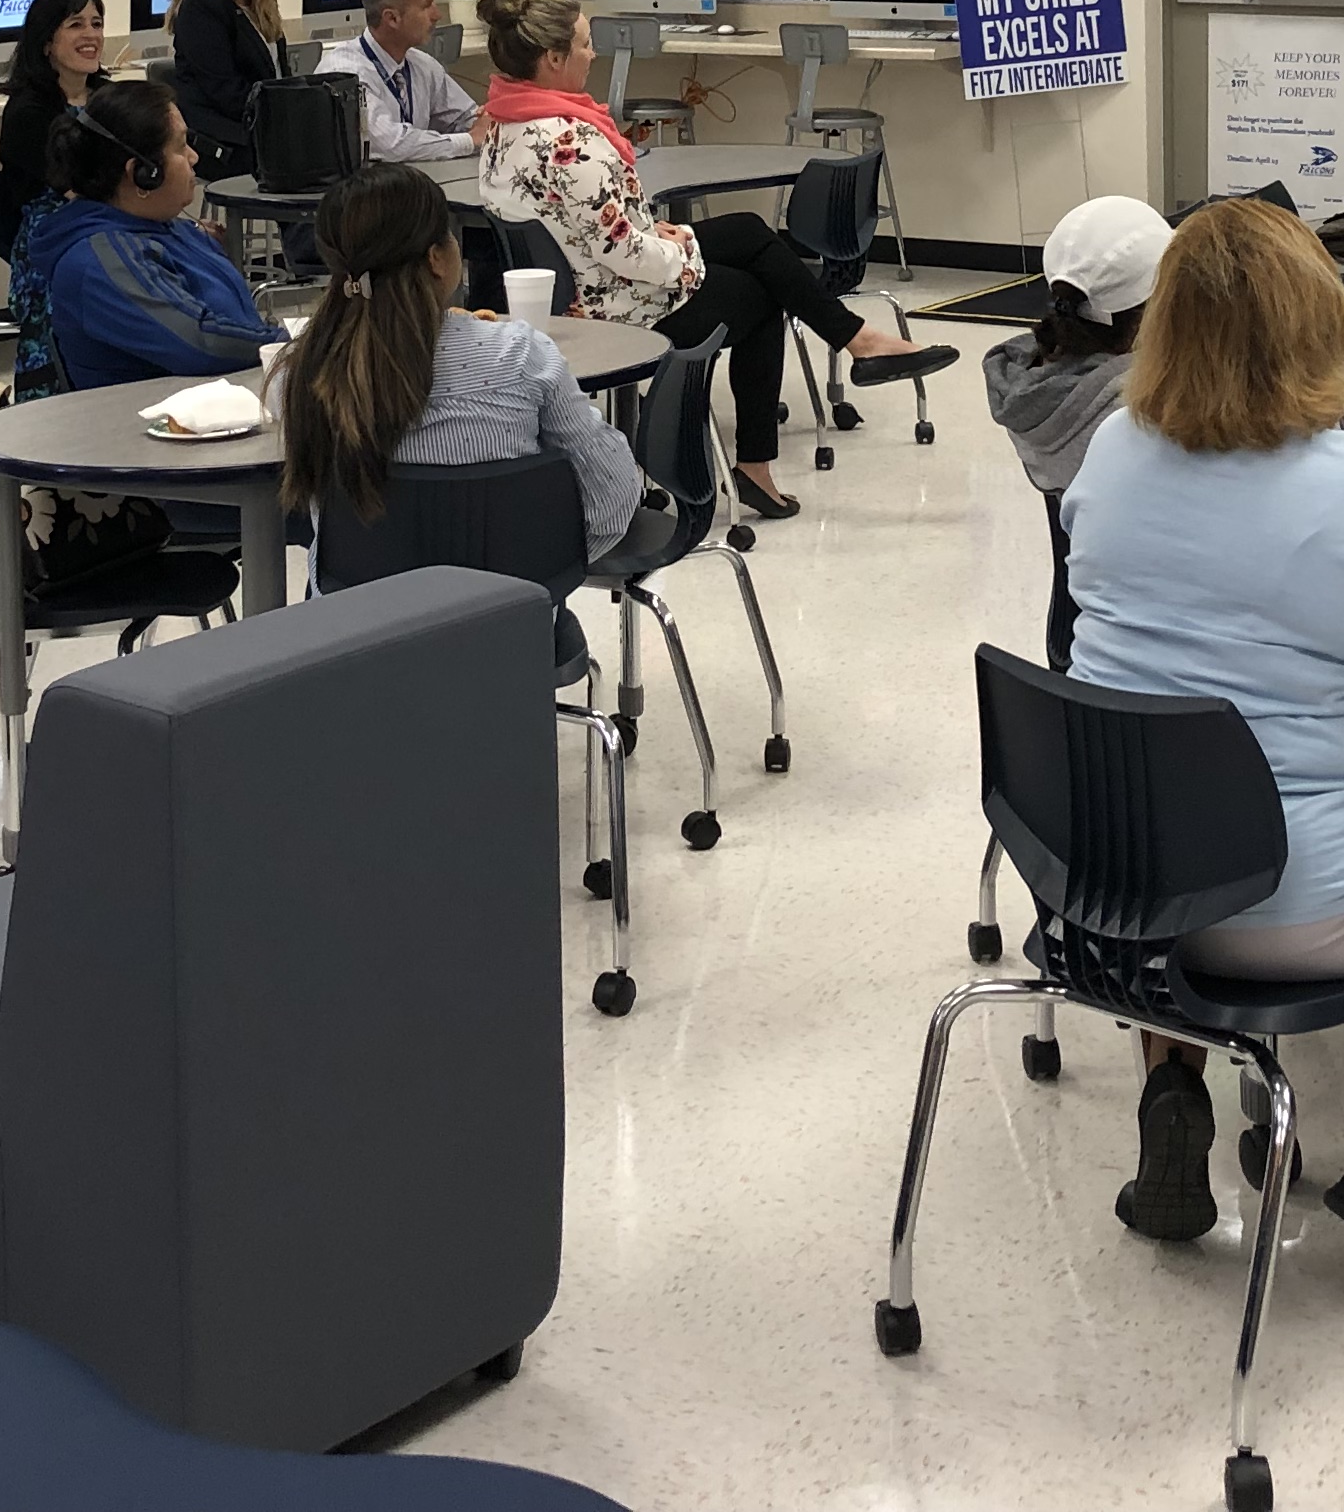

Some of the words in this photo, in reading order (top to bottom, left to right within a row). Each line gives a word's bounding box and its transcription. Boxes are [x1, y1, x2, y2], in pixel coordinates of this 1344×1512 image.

[981, 12, 1070, 61] EXCELS
[1075, 9, 1101, 51] AT
[1274, 52, 1304, 63] KEEP
[1305, 52, 1341, 64] YOUR
[970, 69, 1005, 98] FITZ
[1007, 56, 1124, 93] INTERMEDIATE
[1275, 69, 1340, 81] MEMORIES
[1298, 164, 1335, 174] FALCONS
